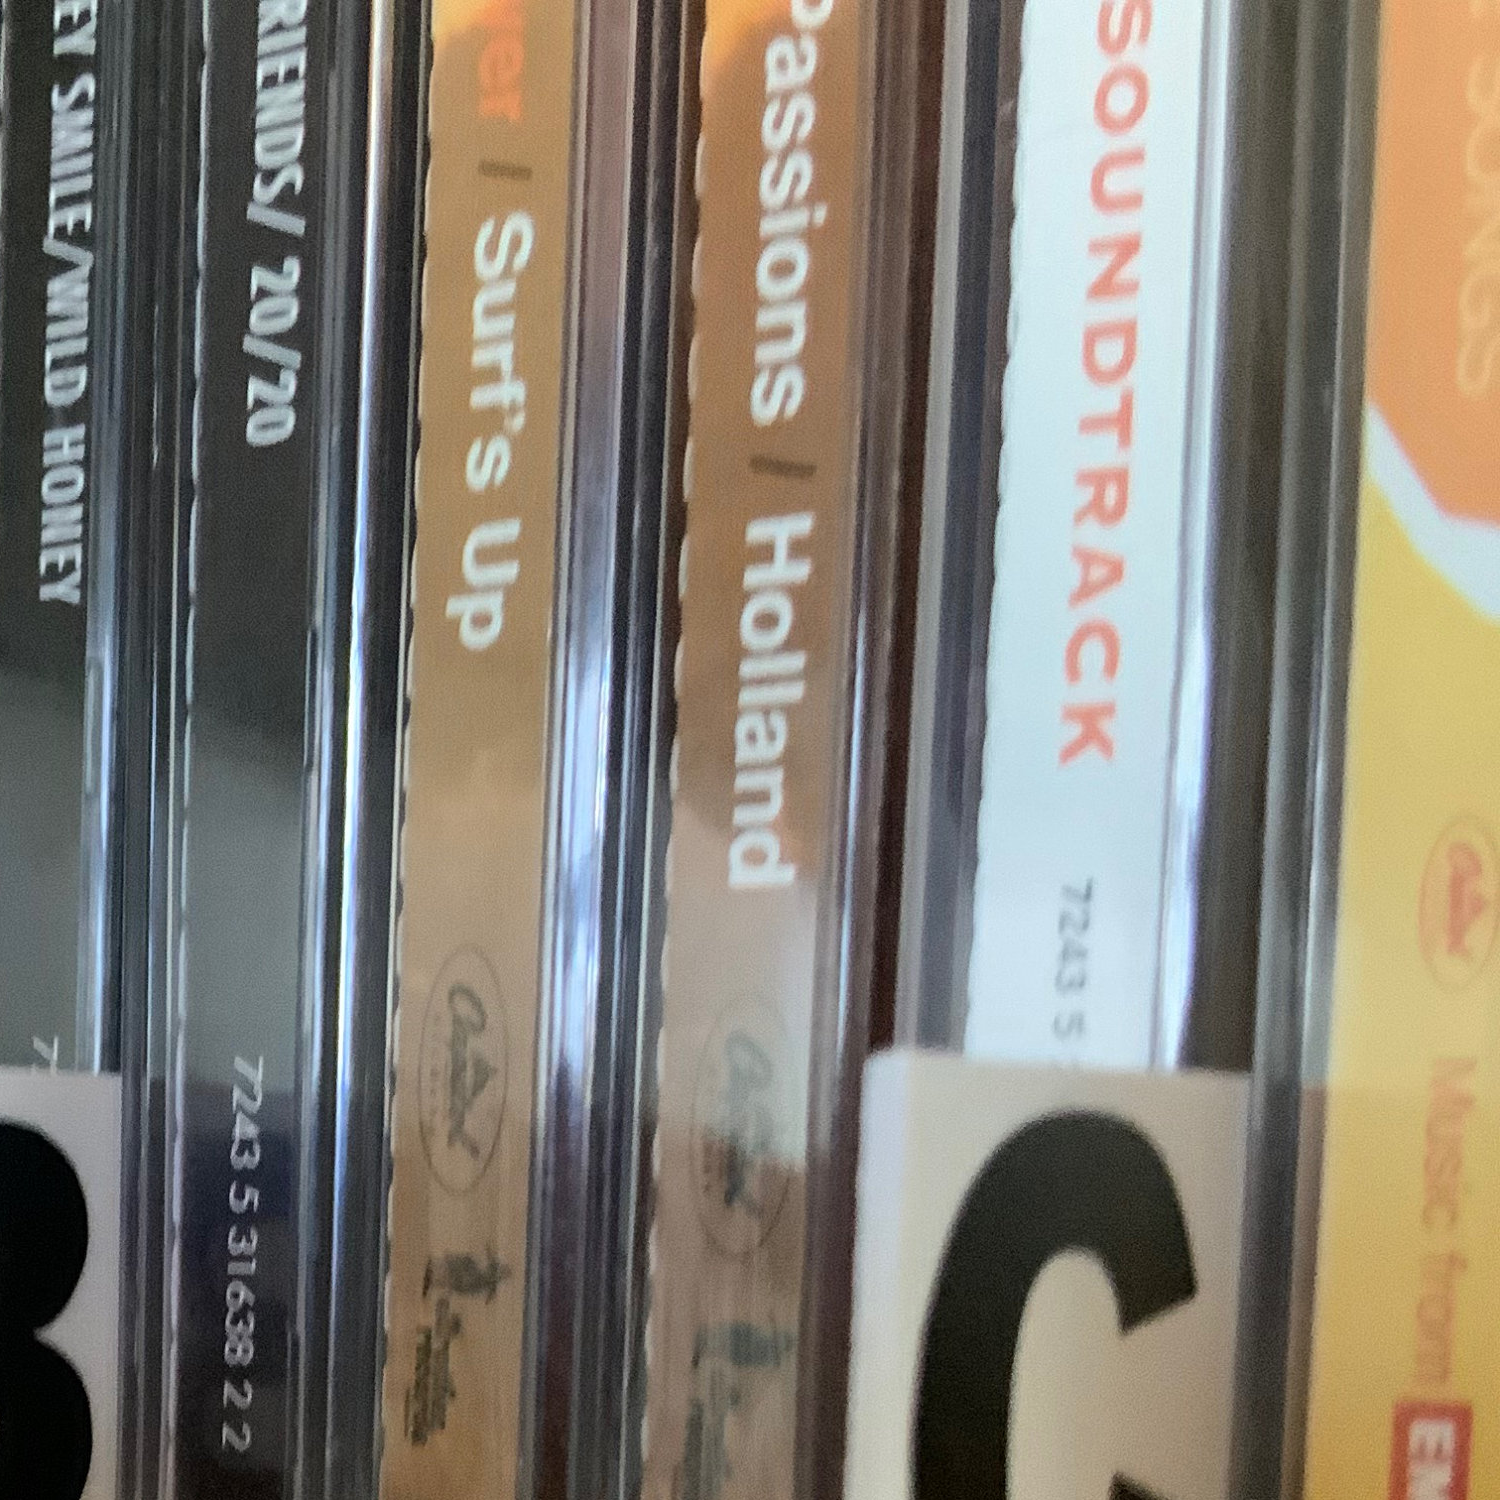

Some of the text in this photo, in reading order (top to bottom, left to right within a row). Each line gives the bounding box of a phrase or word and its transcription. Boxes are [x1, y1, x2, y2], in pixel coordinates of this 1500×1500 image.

[241, 255, 303, 448] 20/20
[465, 209, 536, 494] Surf's
[1057, 0, 1154, 767] SOUNDTRACK
[38, 420, 87, 605] HONEY
[445, 515, 524, 652] Up
[727, 511, 816, 890] Holland
[1052, 877, 1096, 1040] 7243 5
[221, 1054, 265, 1453] 7243 5 31638 2 2
